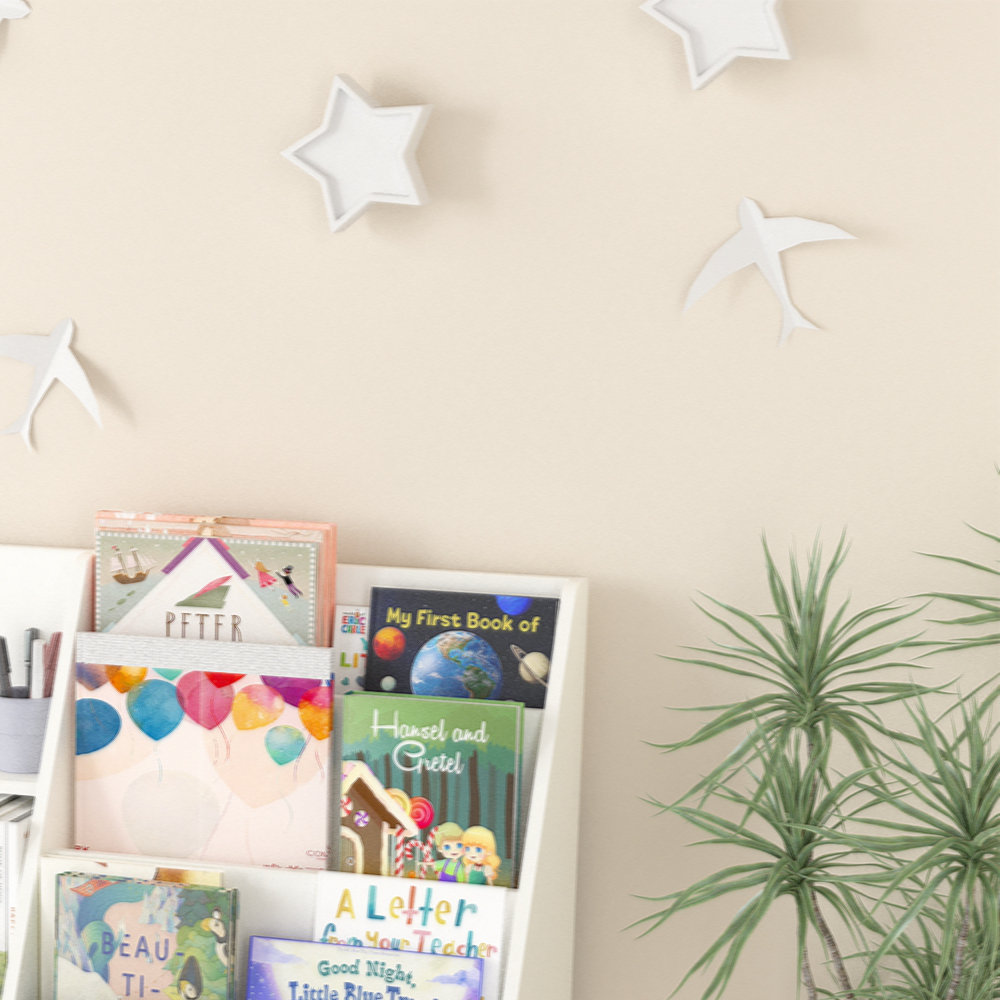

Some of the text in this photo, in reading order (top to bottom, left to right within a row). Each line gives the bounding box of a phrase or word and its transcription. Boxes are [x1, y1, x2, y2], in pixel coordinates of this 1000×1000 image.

[165, 610, 243, 642] PETER
[386, 607, 541, 633] My First Book of
[370, 708, 490, 743] Hansel and
[392, 740, 465, 774] Gretel
[335, 885, 478, 927] A Letter
[101, 931, 184, 961] BEAU-
[412, 929, 498, 958] Teacher
[121, 973, 161, 998] TI-
[318, 959, 417, 988] Good Night,
